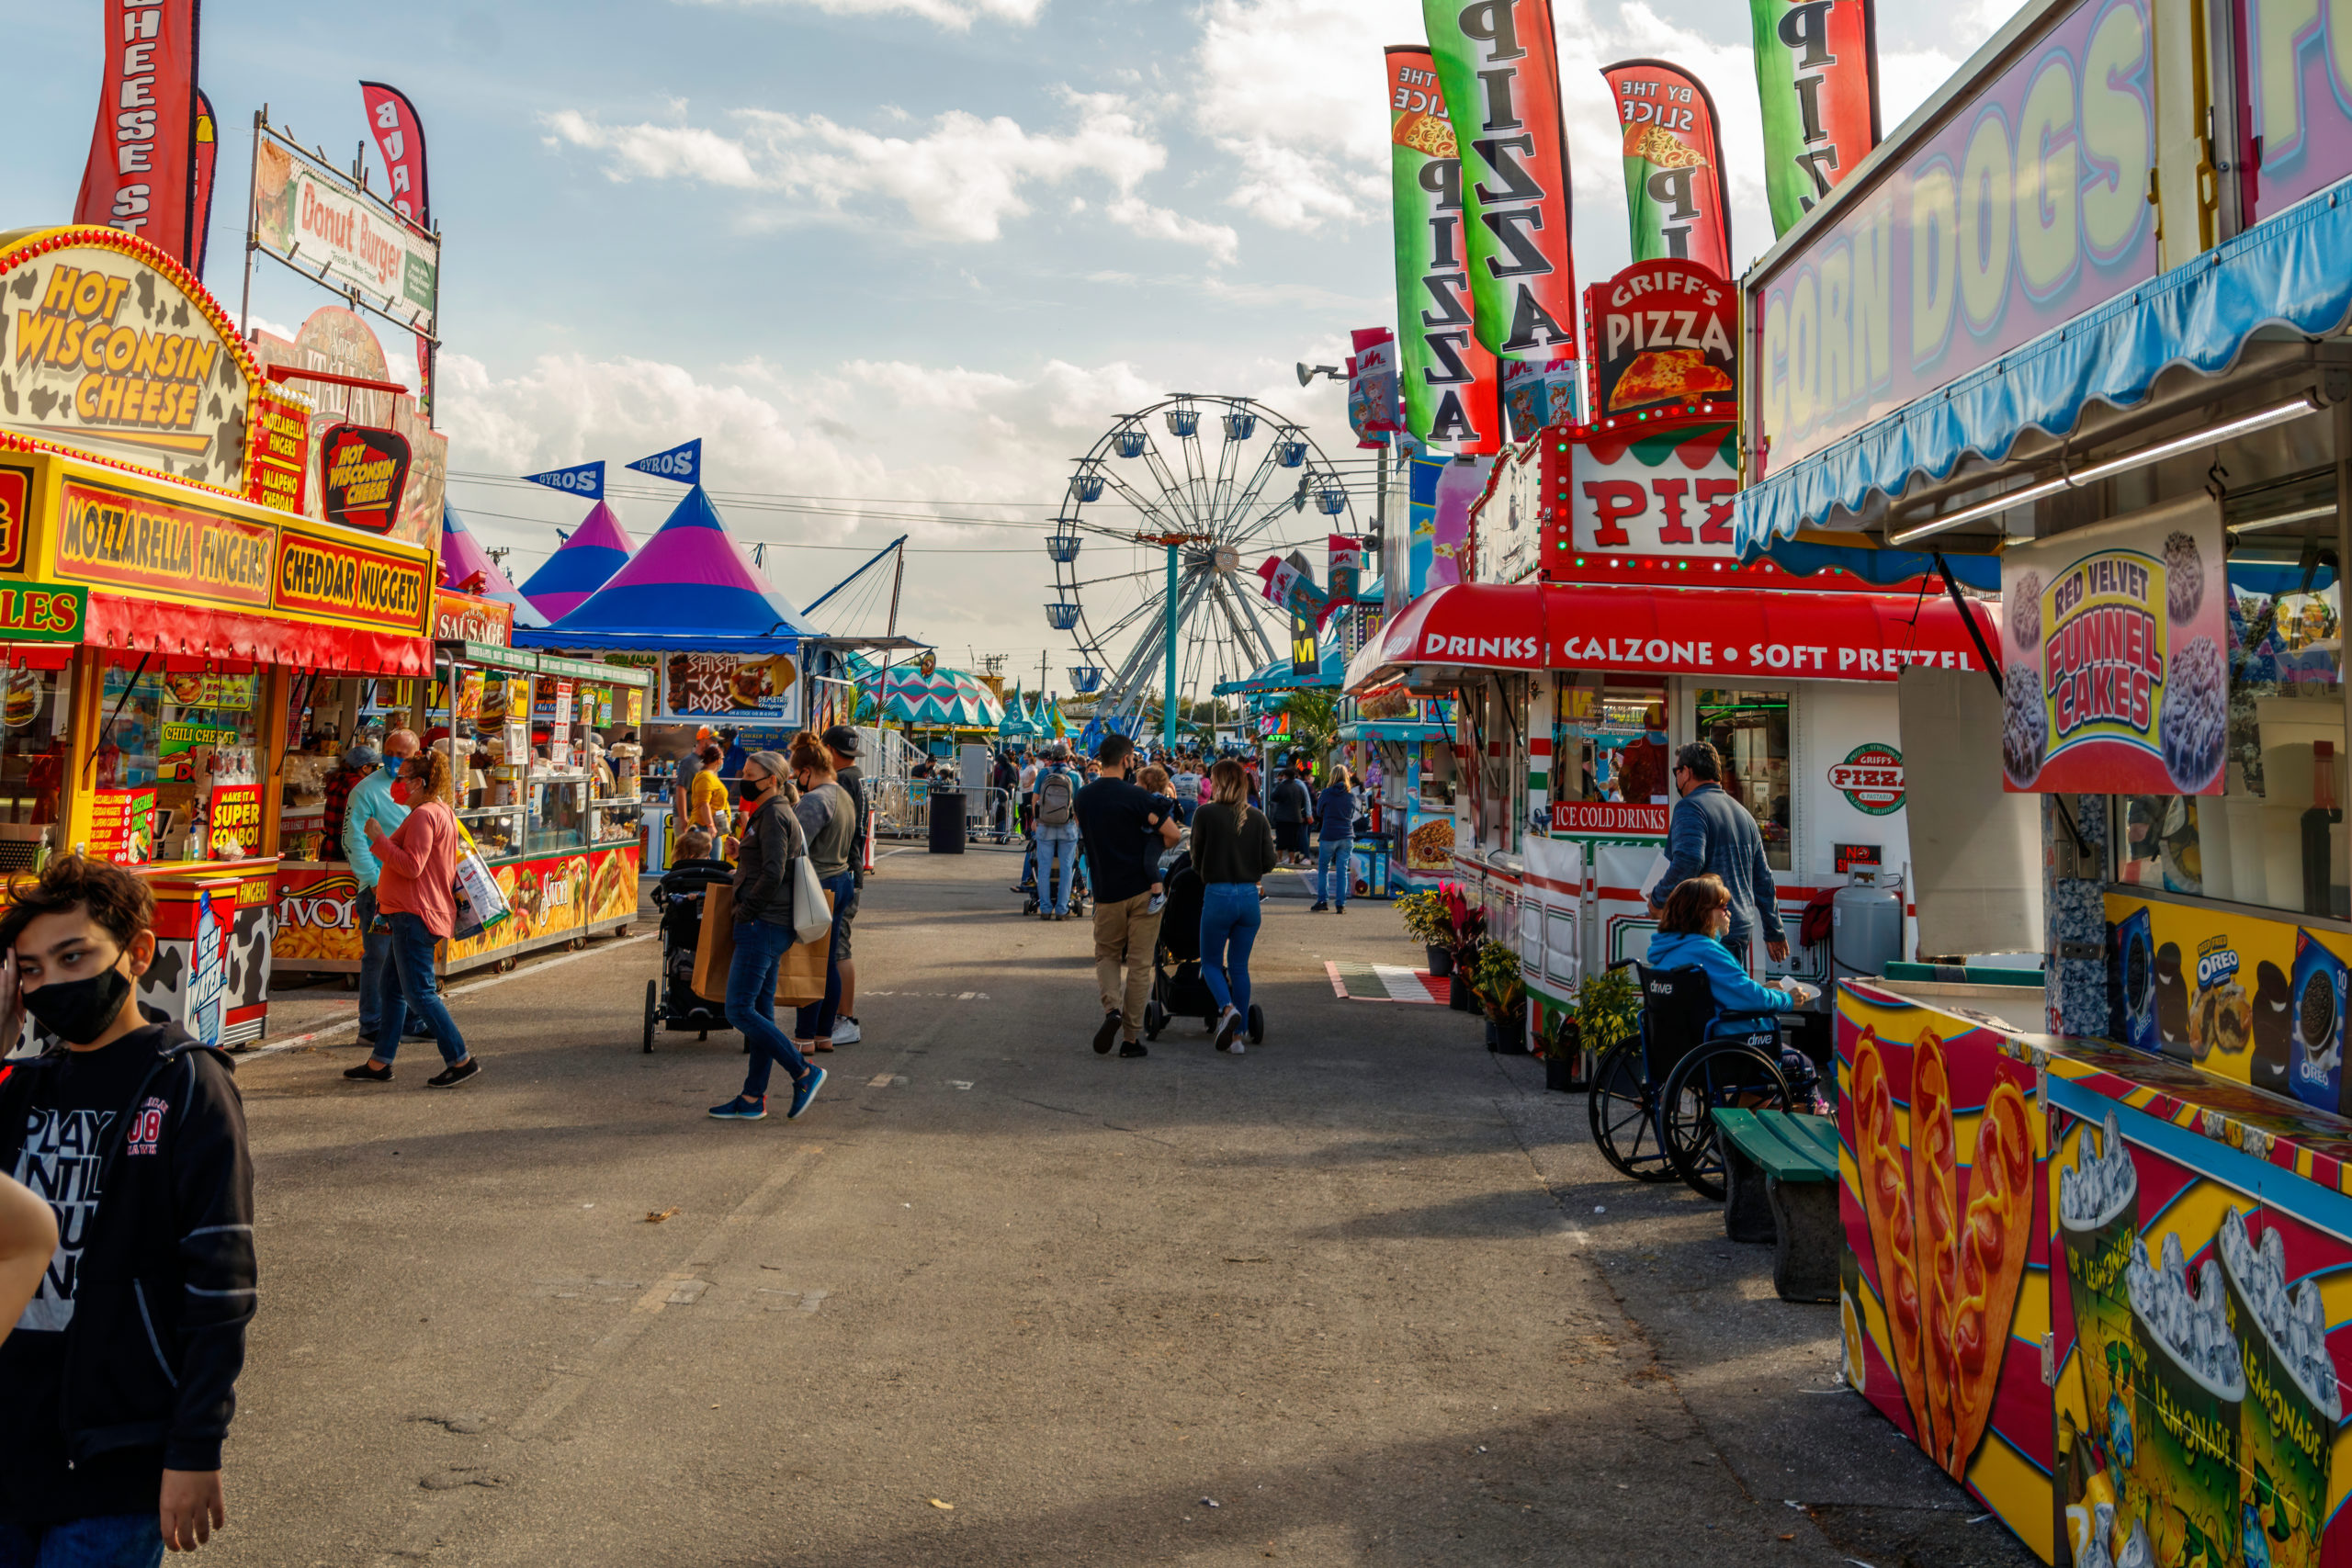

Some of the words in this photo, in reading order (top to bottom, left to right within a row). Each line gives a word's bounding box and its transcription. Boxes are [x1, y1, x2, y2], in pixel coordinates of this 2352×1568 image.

[301, 181, 355, 254] Donut
[359, 211, 402, 284] Burger
[1764, 209, 1893, 450] CORN
[1912, 3, 2151, 364] DOGS
[45, 264, 130, 320] HOT
[1611, 272, 1723, 307] GRIFF'S
[17, 310, 219, 388] WISCONSIN
[1608, 310, 1734, 362] PIZZA
[76, 372, 200, 427] CHEESE
[263, 411, 305, 440] MOZZARELLA
[269, 433, 297, 457] FINGERS
[337, 444, 367, 466] HOT
[329, 458, 397, 491] WISCONSIN
[639, 451, 693, 475] GYROS
[262, 468, 298, 494] JALAPENO
[346, 479, 390, 505] CHEESE
[539, 470, 597, 491] GYROS
[262, 490, 294, 513] CHEDDAR
[1582, 478, 1736, 547] PIZ
[61, 495, 194, 582] MOZZARELLA
[198, 519, 269, 590] FINGERS
[282, 547, 356, 604] CHEDDAR
[359, 558, 420, 617] NUGGETS
[2054, 570, 2083, 622] RED
[2088, 560, 2149, 605] VELVET
[439, 614, 506, 646] SAUSAGE
[687, 653, 739, 674] SHISH
[1425, 633, 1538, 660] DRINKS
[1564, 637, 1713, 665] CALZONE
[1748, 643, 1828, 670] SOFT
[2045, 604, 2164, 697] FUNNEL
[689, 692, 736, 715] BOBS
[2055, 663, 2152, 738] CAKES
[164, 727, 193, 741] CHILI
[195, 729, 236, 744] CHEESE
[1267, 734, 1291, 742] ATM
[1860, 756, 1893, 764] GRIFF'S
[1835, 769, 1905, 787] PIZZ
[221, 792, 241, 802] MAKE
[242, 791, 249, 802] IT
[250, 790, 255, 802] A
[213, 804, 260, 827] SUPER
[1555, 806, 1577, 827] ICE
[1579, 807, 1615, 828] COLD
[1617, 807, 1666, 829] DRINKS
[211, 827, 259, 849] COMBO!
[239, 880, 269, 905] FINGERS
[278, 885, 356, 929] ivor
[2197, 950, 2239, 983] OREO
[2336, 968, 2347, 991] 10
[1650, 979, 1673, 995] drive
[1747, 1032, 1773, 1047] drive
[2133, 1013, 2153, 1042] OREO
[2300, 1061, 2330, 1088] OREO
[23, 1106, 118, 1156] PLAY
[24, 1154, 103, 1202] NTIL
[2243, 1337, 2322, 1468] LEMONADE
[2154, 1373, 2232, 1469] LEMONADE
